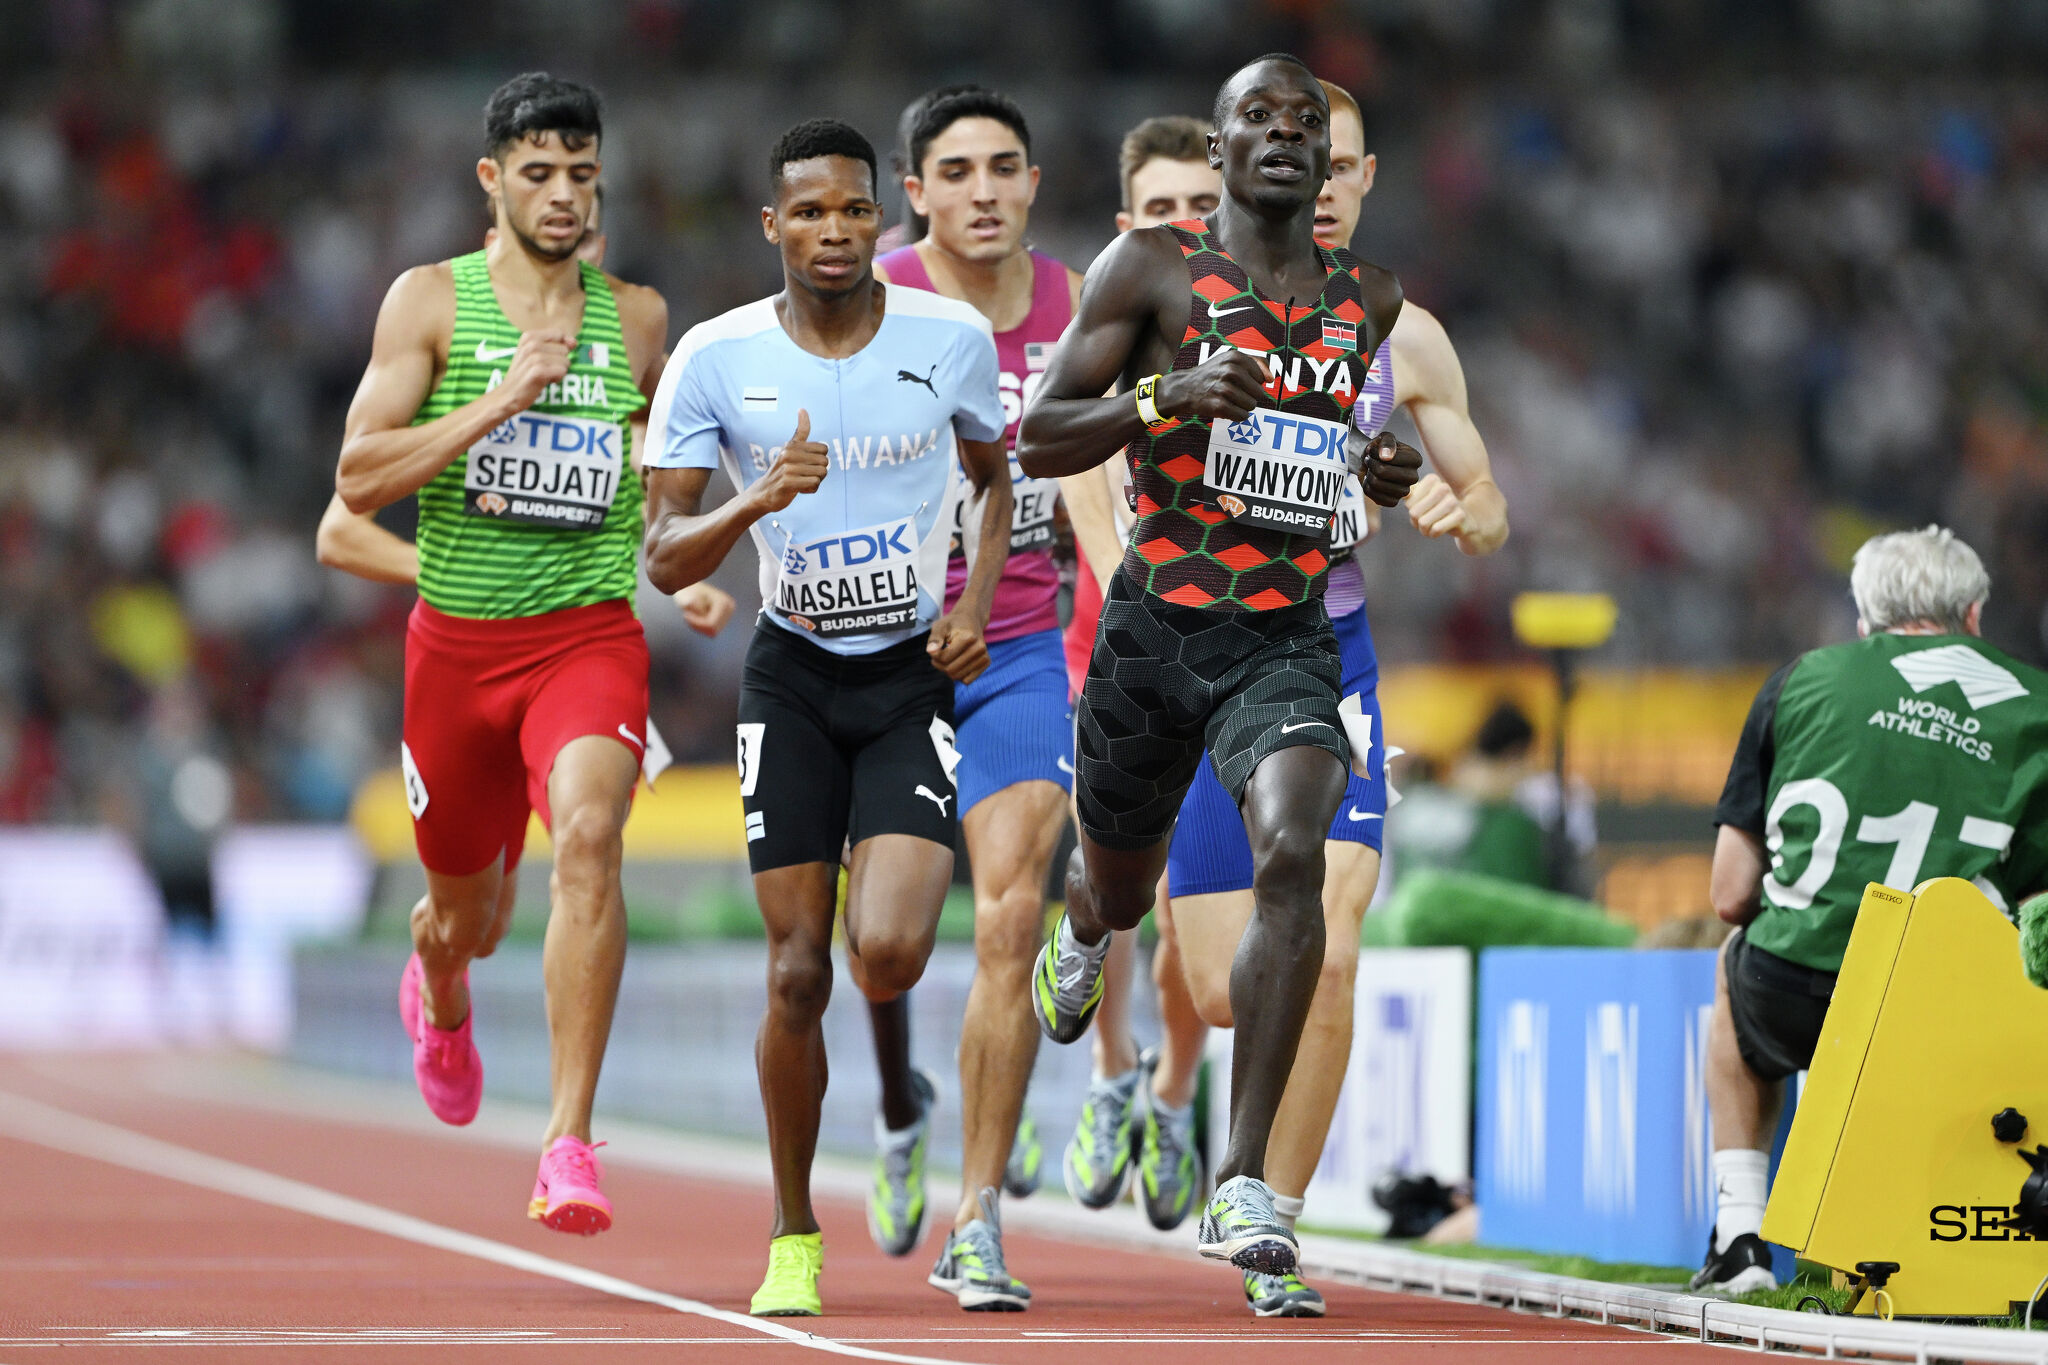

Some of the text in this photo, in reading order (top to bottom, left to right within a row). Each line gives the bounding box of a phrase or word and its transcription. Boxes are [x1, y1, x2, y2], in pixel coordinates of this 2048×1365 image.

[484, 367, 608, 408] AERIA
[1198, 341, 1352, 398] KNYA
[518, 416, 613, 460] TDK
[1263, 414, 1348, 464] TDK
[475, 453, 611, 502] SEDJATI
[511, 500, 593, 523] BUDAPEST
[1251, 505, 1327, 529] BUDAPES
[805, 523, 912, 569] TDK
[781, 564, 918, 612] MASALELA
[821, 610, 907, 631] BUDAPEST
[1867, 709, 1993, 761] ATHLETICS
[1898, 696, 1981, 734] WORLD
[1871, 890, 1903, 905] SEIKO
[1929, 1205, 2048, 1242] SE
